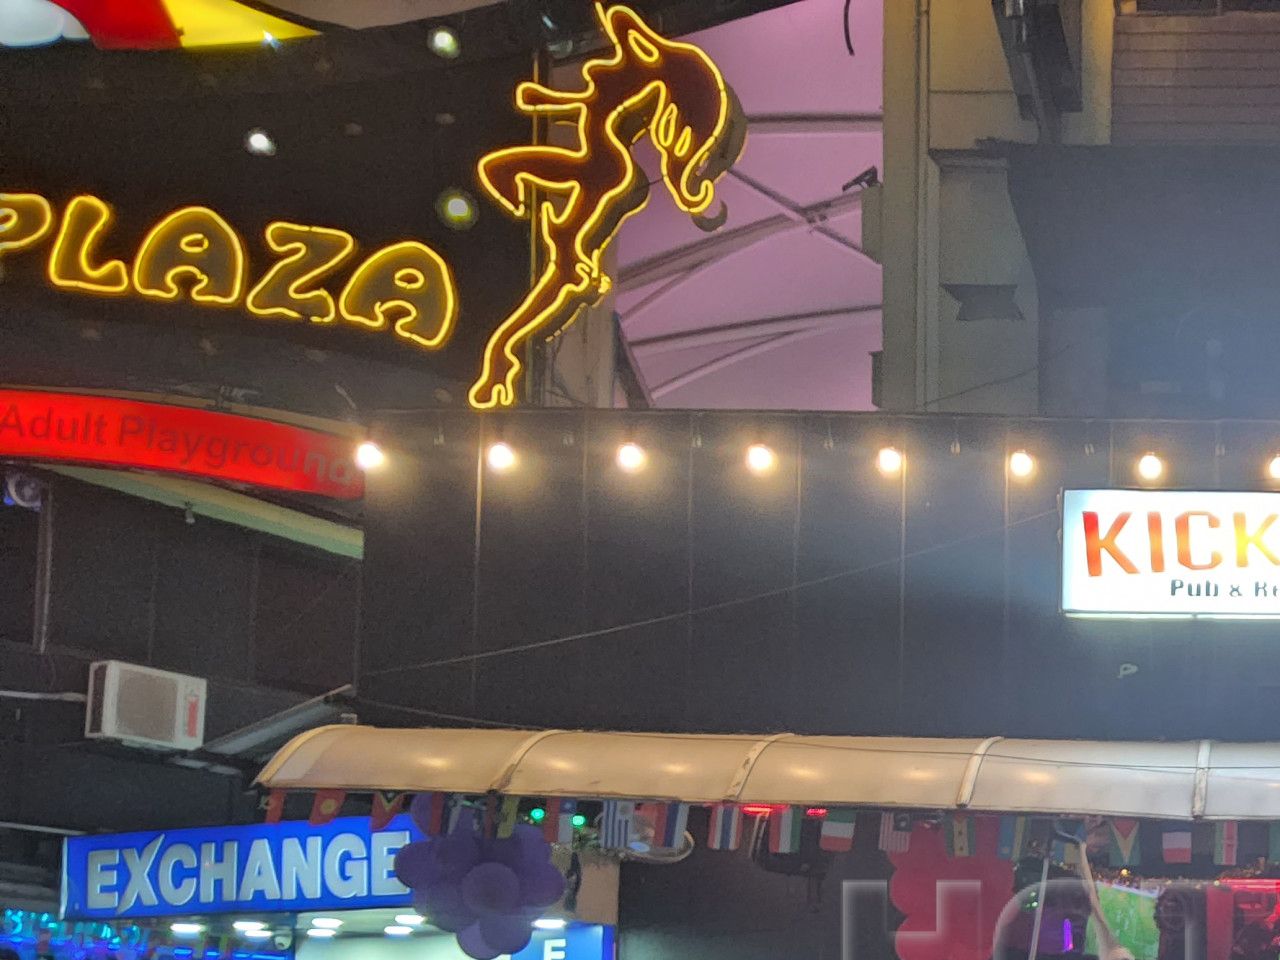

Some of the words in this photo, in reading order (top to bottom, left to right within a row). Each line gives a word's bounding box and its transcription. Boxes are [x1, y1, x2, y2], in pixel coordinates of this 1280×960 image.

[0, 402, 108, 446] Adult
[1170, 579, 1219, 597] Pub
[86, 831, 412, 915] EXCHANGE
